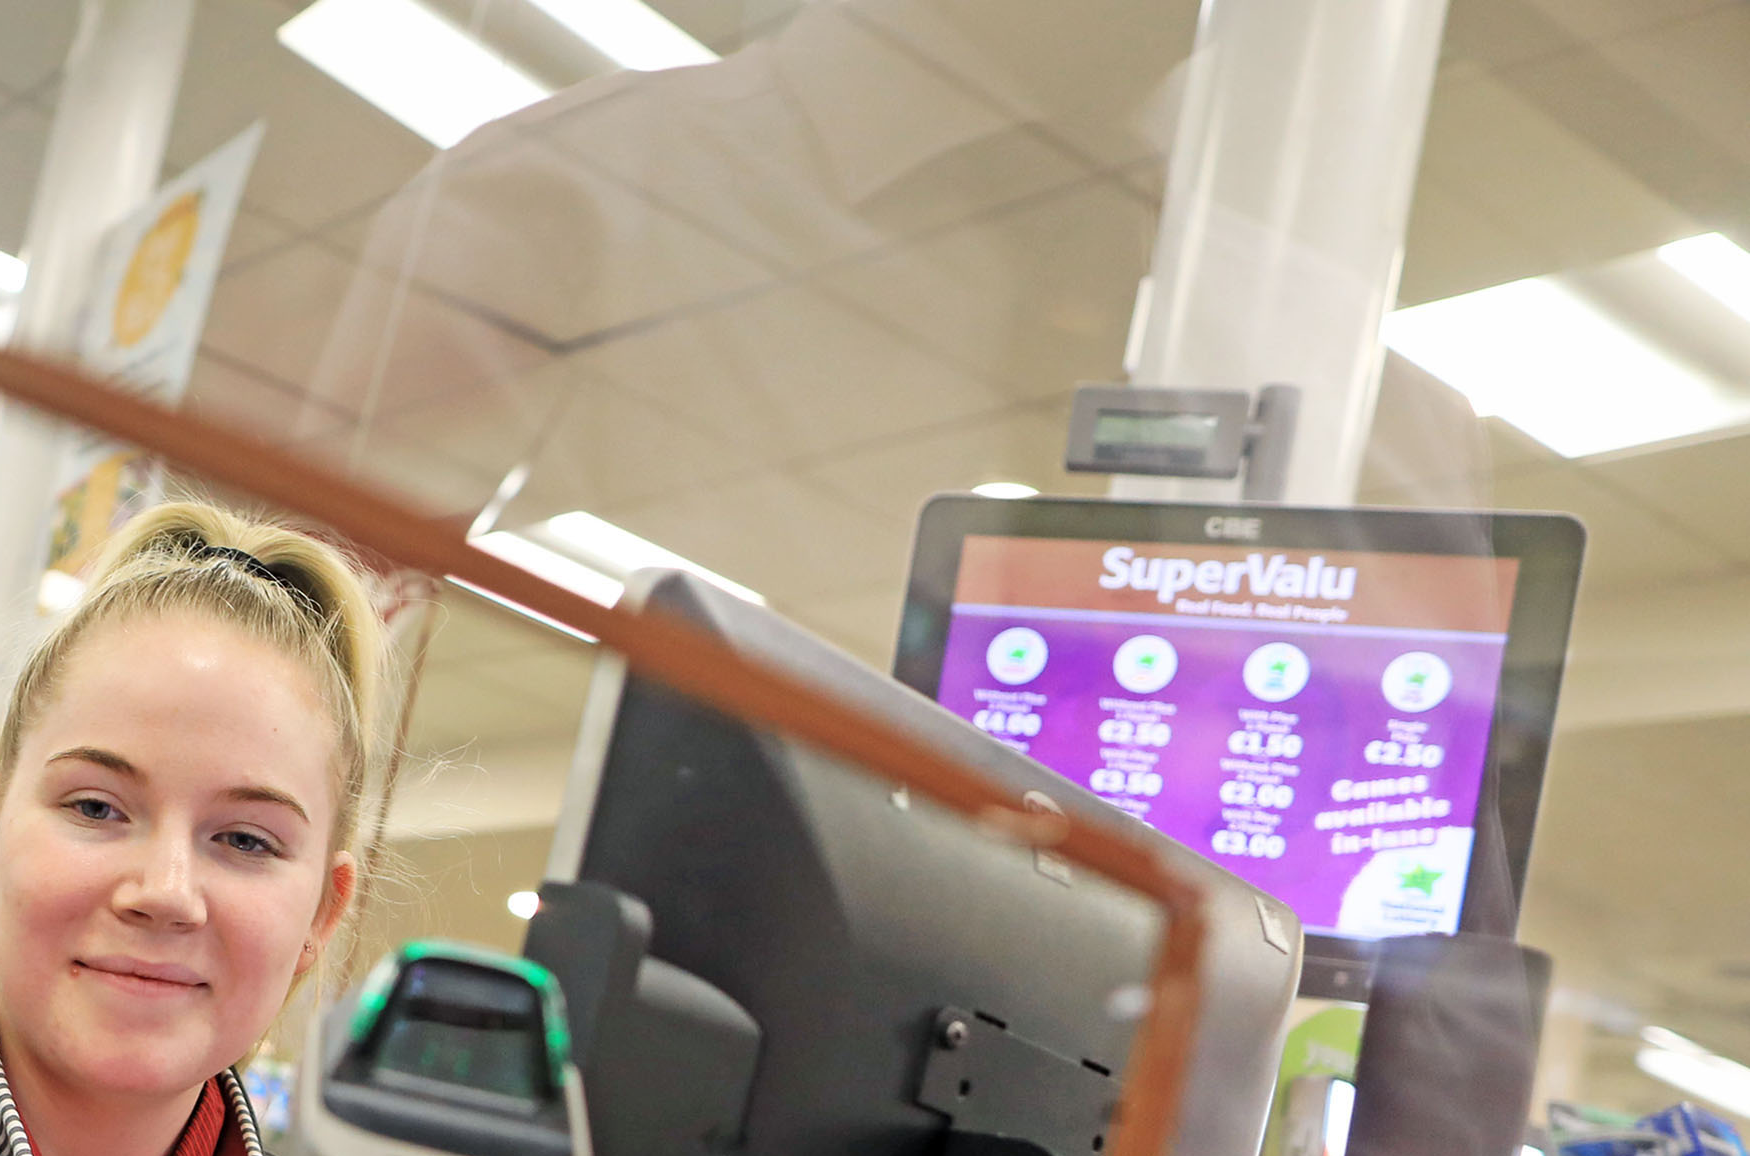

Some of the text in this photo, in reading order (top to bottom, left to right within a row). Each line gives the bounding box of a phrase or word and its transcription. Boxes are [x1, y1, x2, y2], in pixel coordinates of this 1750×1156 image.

[1099, 546, 1357, 603] SuperValu
[1364, 740, 1444, 768] €2.50
[1331, 775, 1429, 802] Games
[1314, 796, 1451, 830] available
